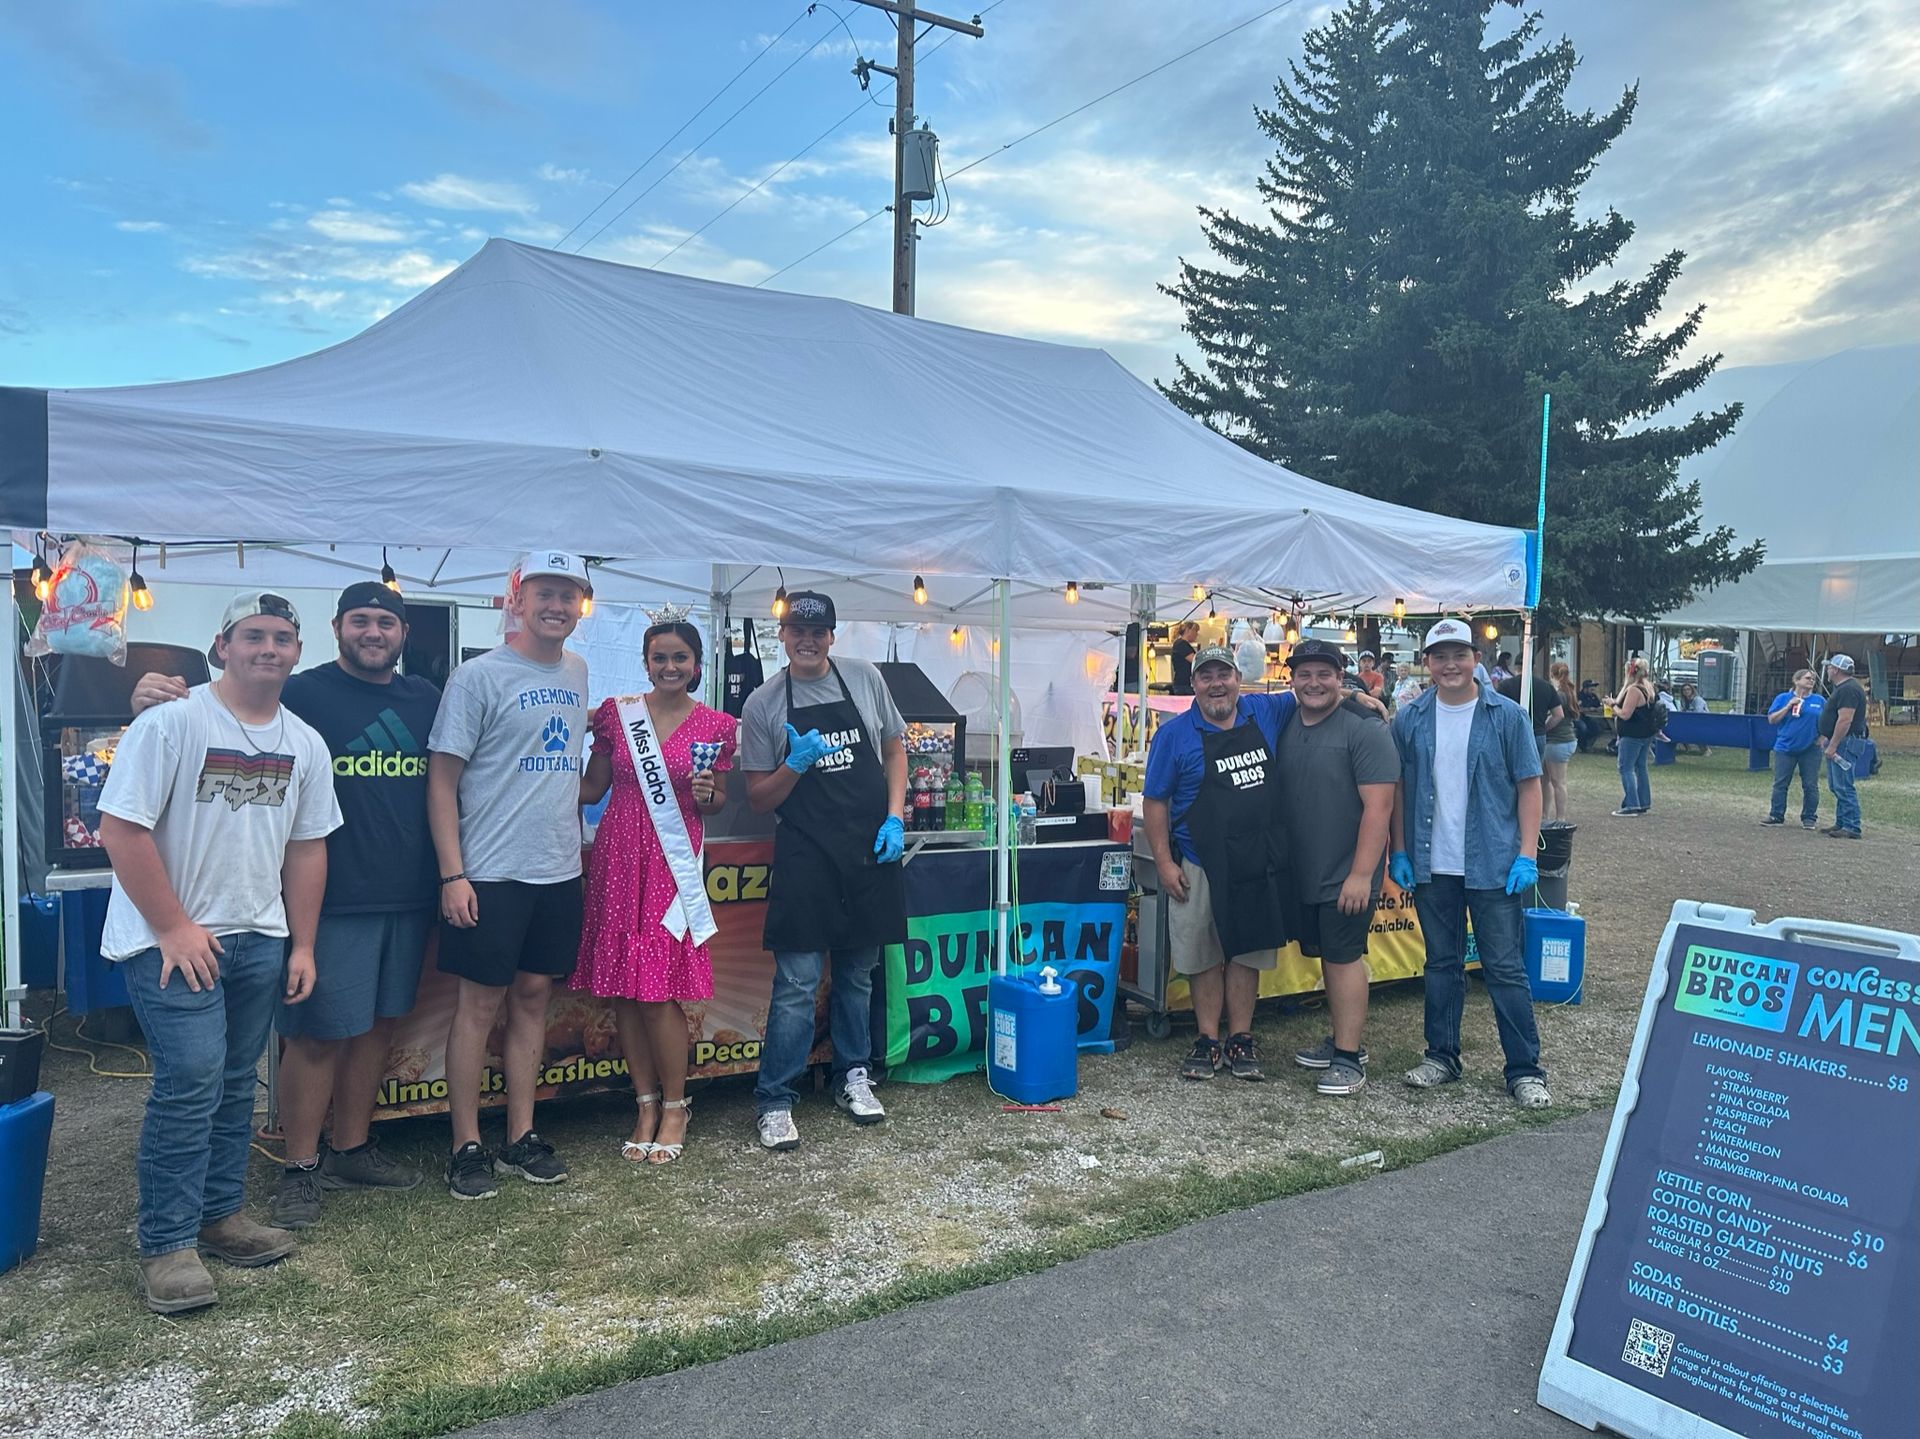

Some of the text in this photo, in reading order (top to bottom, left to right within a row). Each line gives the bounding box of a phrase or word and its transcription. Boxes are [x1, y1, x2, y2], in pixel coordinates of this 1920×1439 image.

[518, 688, 581, 711] FREMONT
[820, 728, 861, 748] NCAN
[333, 750, 428, 777] adidas
[517, 756, 578, 773] FOOTBALL
[629, 719, 650, 755] Miss
[640, 754, 666, 805] Idaho
[1215, 747, 1268, 773] DUNCAN
[1230, 765, 1265, 786] BROS
[1375, 893, 1396, 911] de
[1368, 918, 1415, 934] vailable
[904, 920, 1113, 986] DUNCAN
[1542, 944, 1570, 957] CUBE
[1691, 952, 1791, 985] DUNCAN
[1685, 970, 1786, 1013] BROS
[906, 969, 1105, 1061] BS
[995, 1017, 1016, 1037] CUBE
[1798, 992, 1920, 1057] MEN
[696, 1041, 764, 1065] Peca
[1692, 1032, 1909, 1092] LEMONADE SHAKERS $8
[1706, 1063, 1753, 1084] FLAVORS:
[1718, 1093, 1790, 1120] PINA COLADA
[1722, 1080, 1789, 1105] STRAWBERRY
[1712, 1118, 1746, 1135] PEACH
[1715, 1105, 1773, 1129] RASPBERRY
[1705, 1143, 1749, 1163] MANGO
[1710, 1130, 1781, 1159] WATERMELON
[1703, 1155, 1849, 1207] STRAWBERRY-PINA COLADA
[1657, 1169, 1885, 1253] KETTLE CORN $10
[1647, 1205, 1824, 1276] ROASTED GLAZED NUTS
[1652, 1188, 1868, 1270] COTTON CANDY $6
[1652, 1238, 1791, 1295] LARGE 13 OZ $20
[1656, 1225, 1794, 1281] REGULAR 6 OZ $10
[1632, 1261, 1848, 1354] SODAS $4
[1628, 1279, 1844, 1375] WATER BOTTLES $3
[1673, 1355, 1863, 1439] range of treats for large and small events
[1677, 1342, 1849, 1421] Contact us about offering a delectable
[1670, 1365, 1839, 1439] throughout the Mountain West regio
